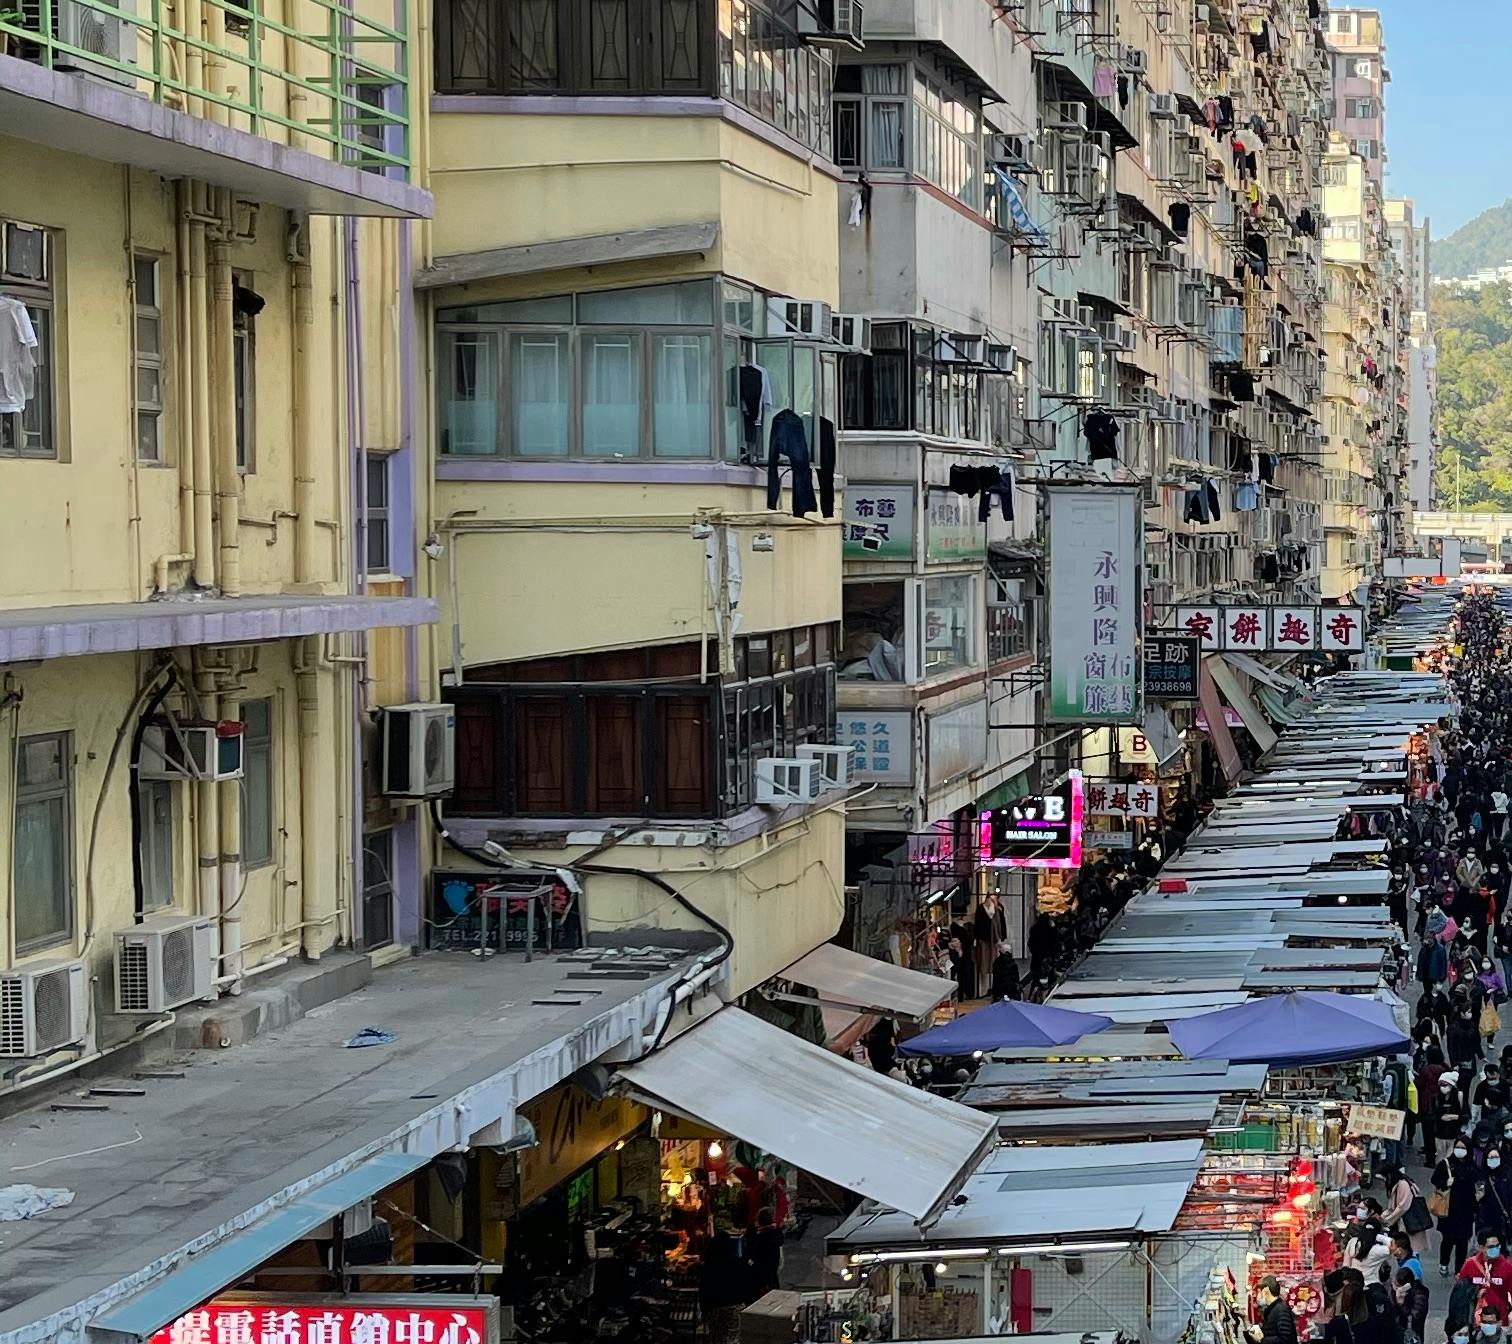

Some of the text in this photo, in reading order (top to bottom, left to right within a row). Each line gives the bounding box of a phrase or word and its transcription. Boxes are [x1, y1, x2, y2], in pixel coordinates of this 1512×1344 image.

[855, 498, 896, 518] 布藝
[1092, 551, 1119, 646] 永興隆
[1144, 664, 1192, 679] 宗按摩
[1132, 735, 1147, 751] B
[1028, 831, 1057, 841] SALON
